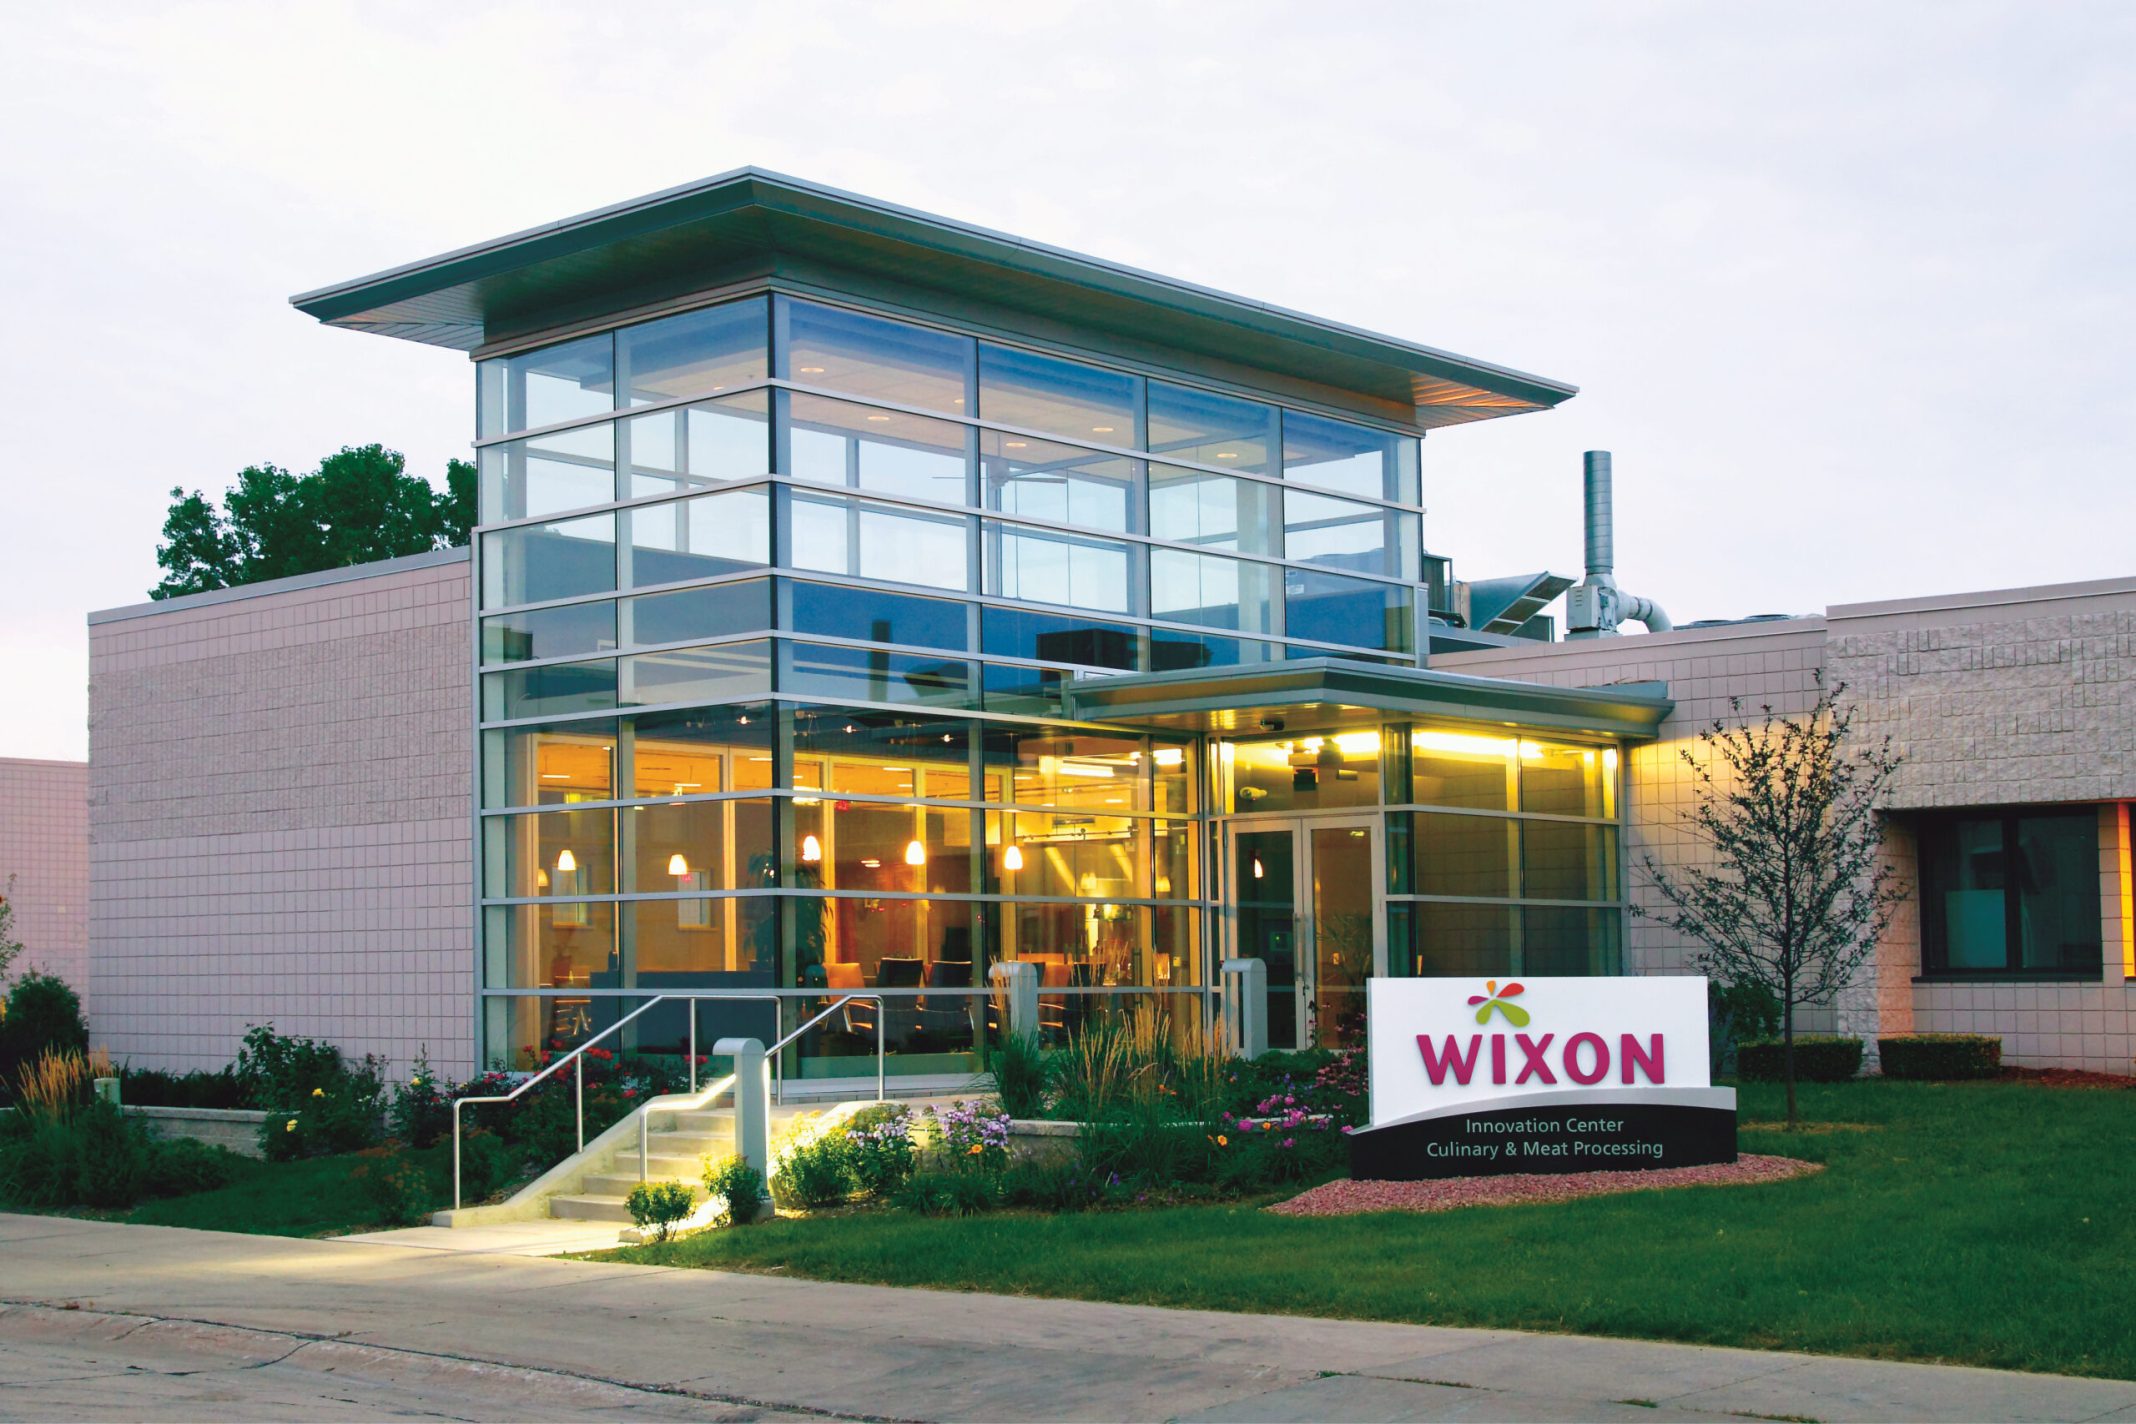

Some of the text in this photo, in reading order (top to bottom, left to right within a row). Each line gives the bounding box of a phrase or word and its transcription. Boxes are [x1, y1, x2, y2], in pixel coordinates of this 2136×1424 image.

[1416, 1032, 1665, 1085] WIXON
[1466, 1117, 1624, 1133] Innovation Center
[1426, 1139, 1663, 1160] Culinary & Meat Processing
